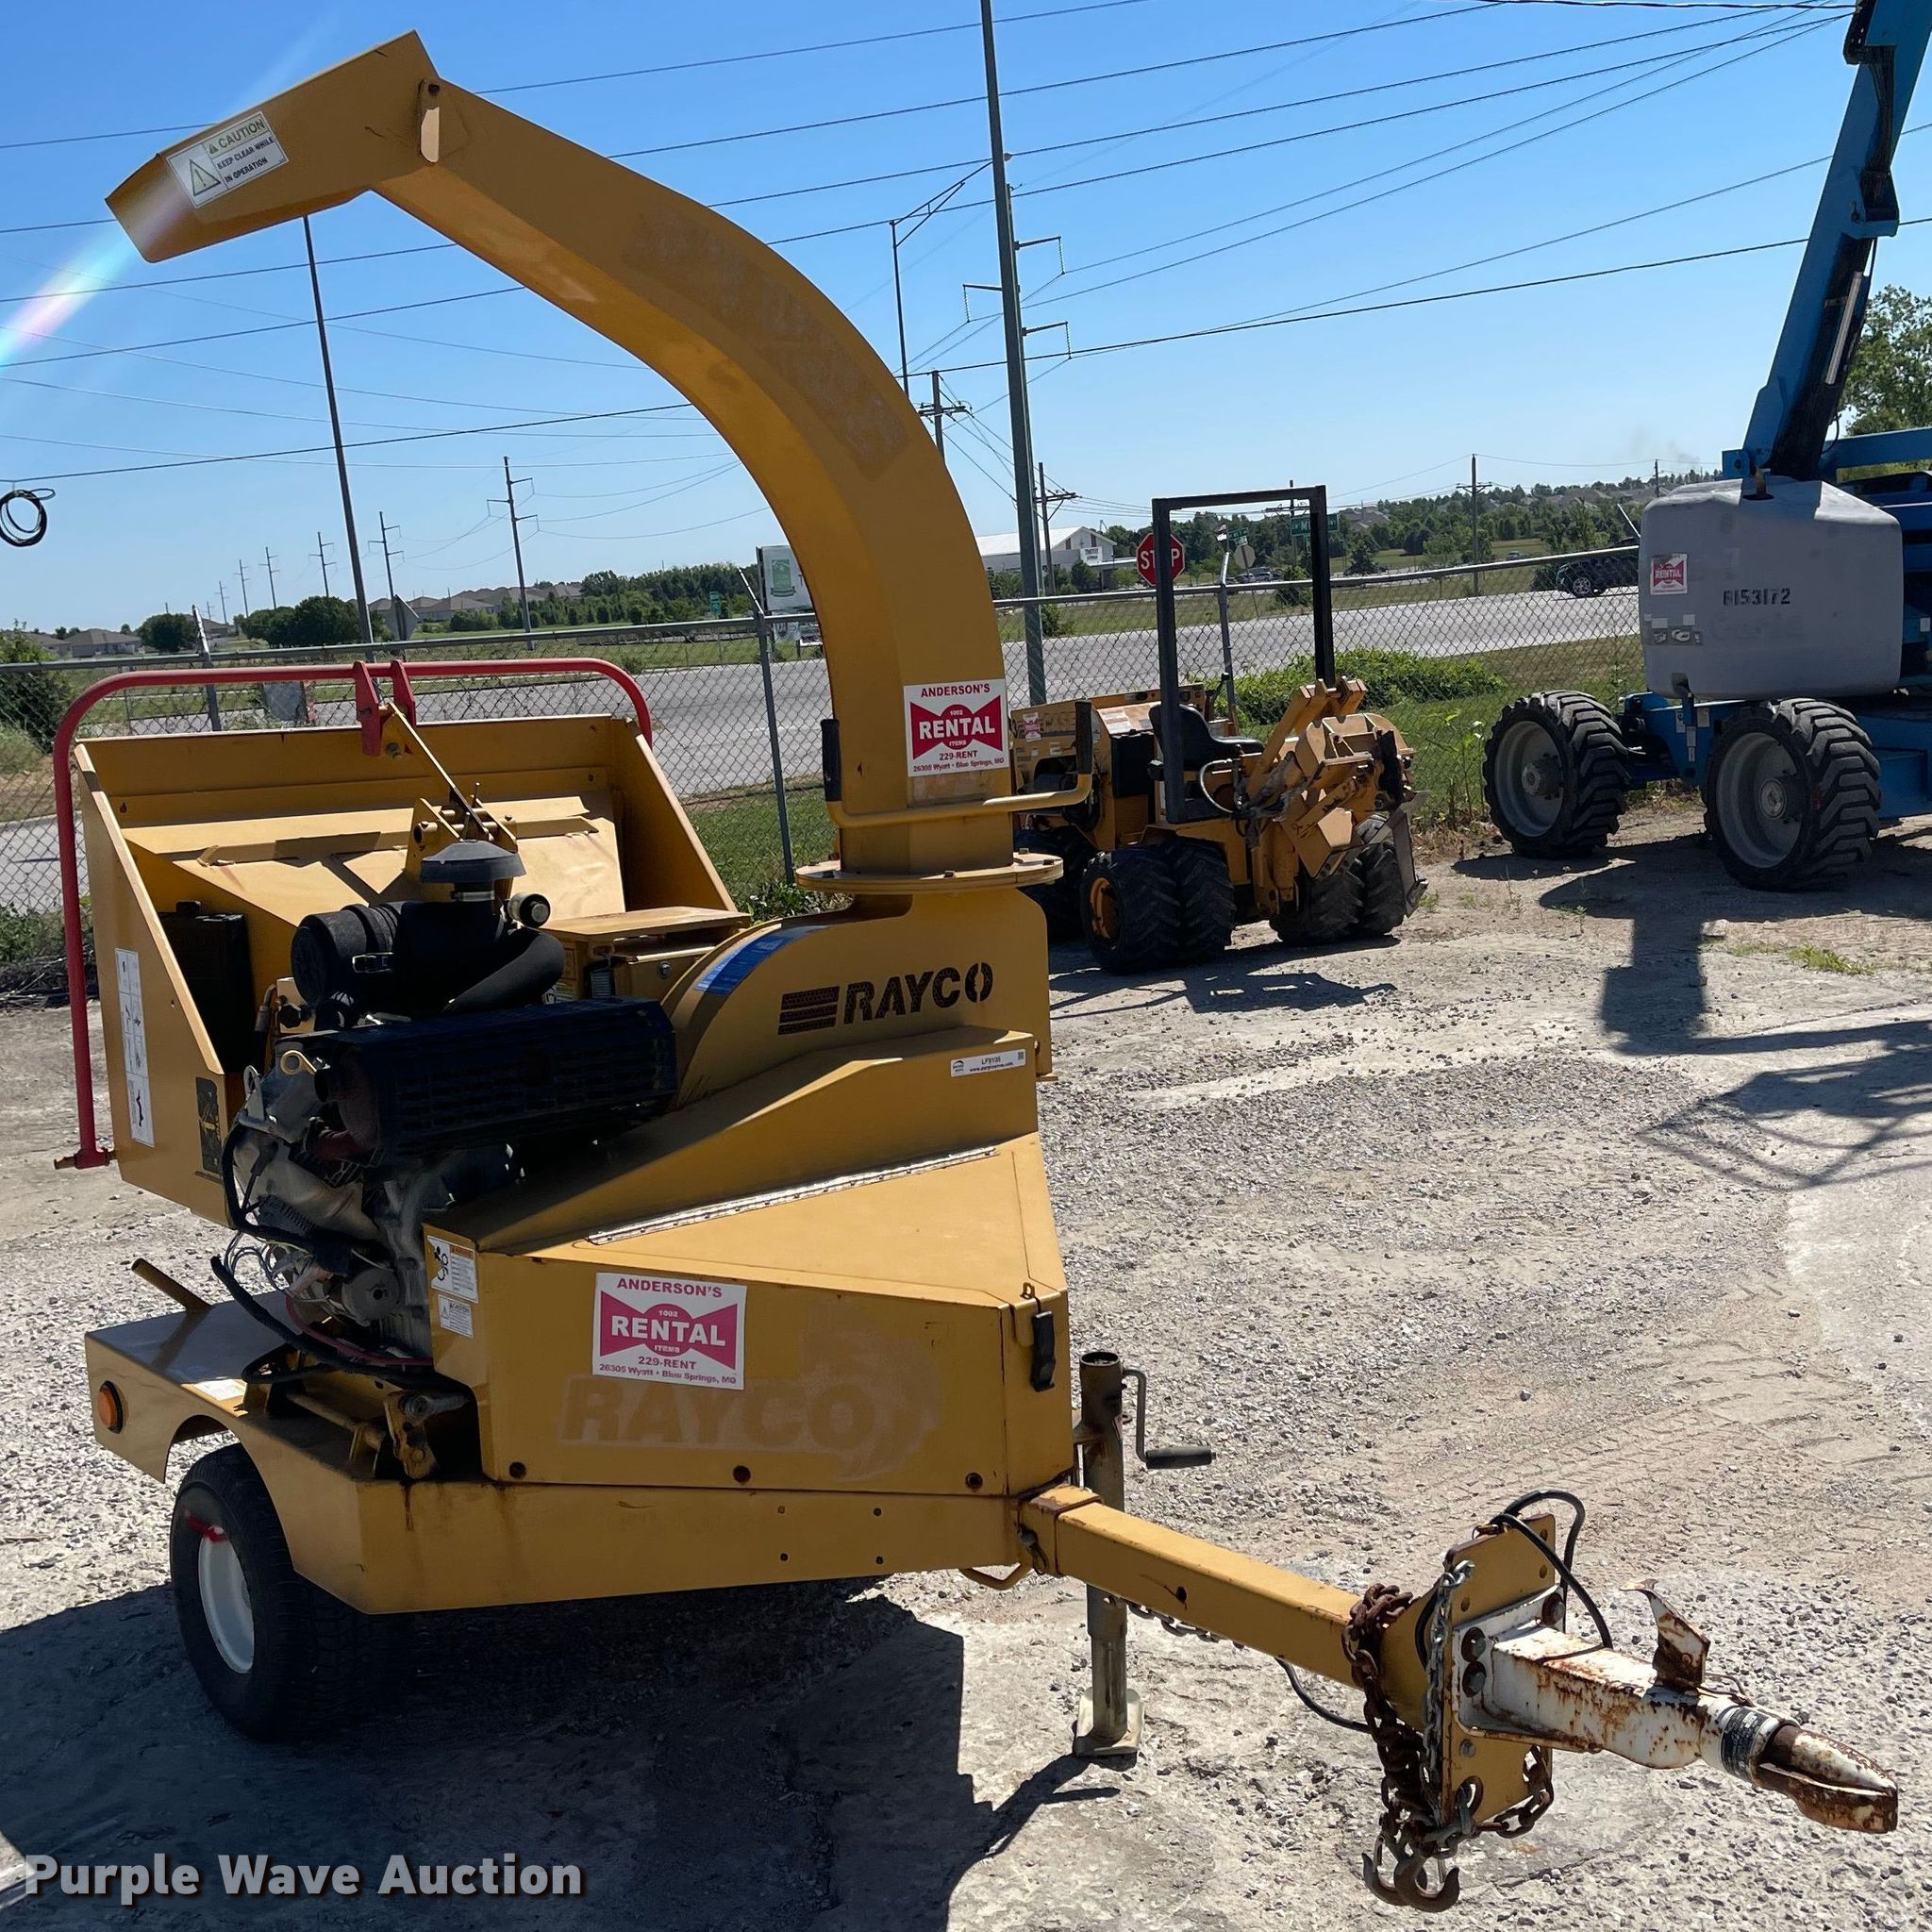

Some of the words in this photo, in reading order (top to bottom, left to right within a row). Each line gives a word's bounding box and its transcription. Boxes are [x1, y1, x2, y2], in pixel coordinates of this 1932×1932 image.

[218, 119, 265, 148] CAUTION
[216, 157, 233, 170] KEEP
[233, 146, 254, 161] CLEAR
[254, 136, 275, 150] WHILE
[224, 175, 233, 183] IN
[232, 157, 268, 179] OPERATION
[1141, 548, 1180, 570] STP
[1655, 568, 1682, 579] RENTAL
[920, 683, 991, 698] ANDERSON'S
[919, 716, 995, 740] RENTAL
[939, 750, 978, 761] 229-RENT
[843, 961, 993, 1024] RAYCO
[617, 1277, 723, 1298] ANDERSON'S
[611, 1315, 726, 1346] RENTAL
[654, 1344, 680, 1354] ITEMS
[599, 1363, 627, 1374] 26305
[627, 1366, 654, 1376] Wyatt
[662, 1370, 682, 1378] Blue
[684, 1372, 719, 1384] Springs,
[638, 1356, 697, 1370] 229-RENT
[561, 1377, 874, 1450] RAYCO
